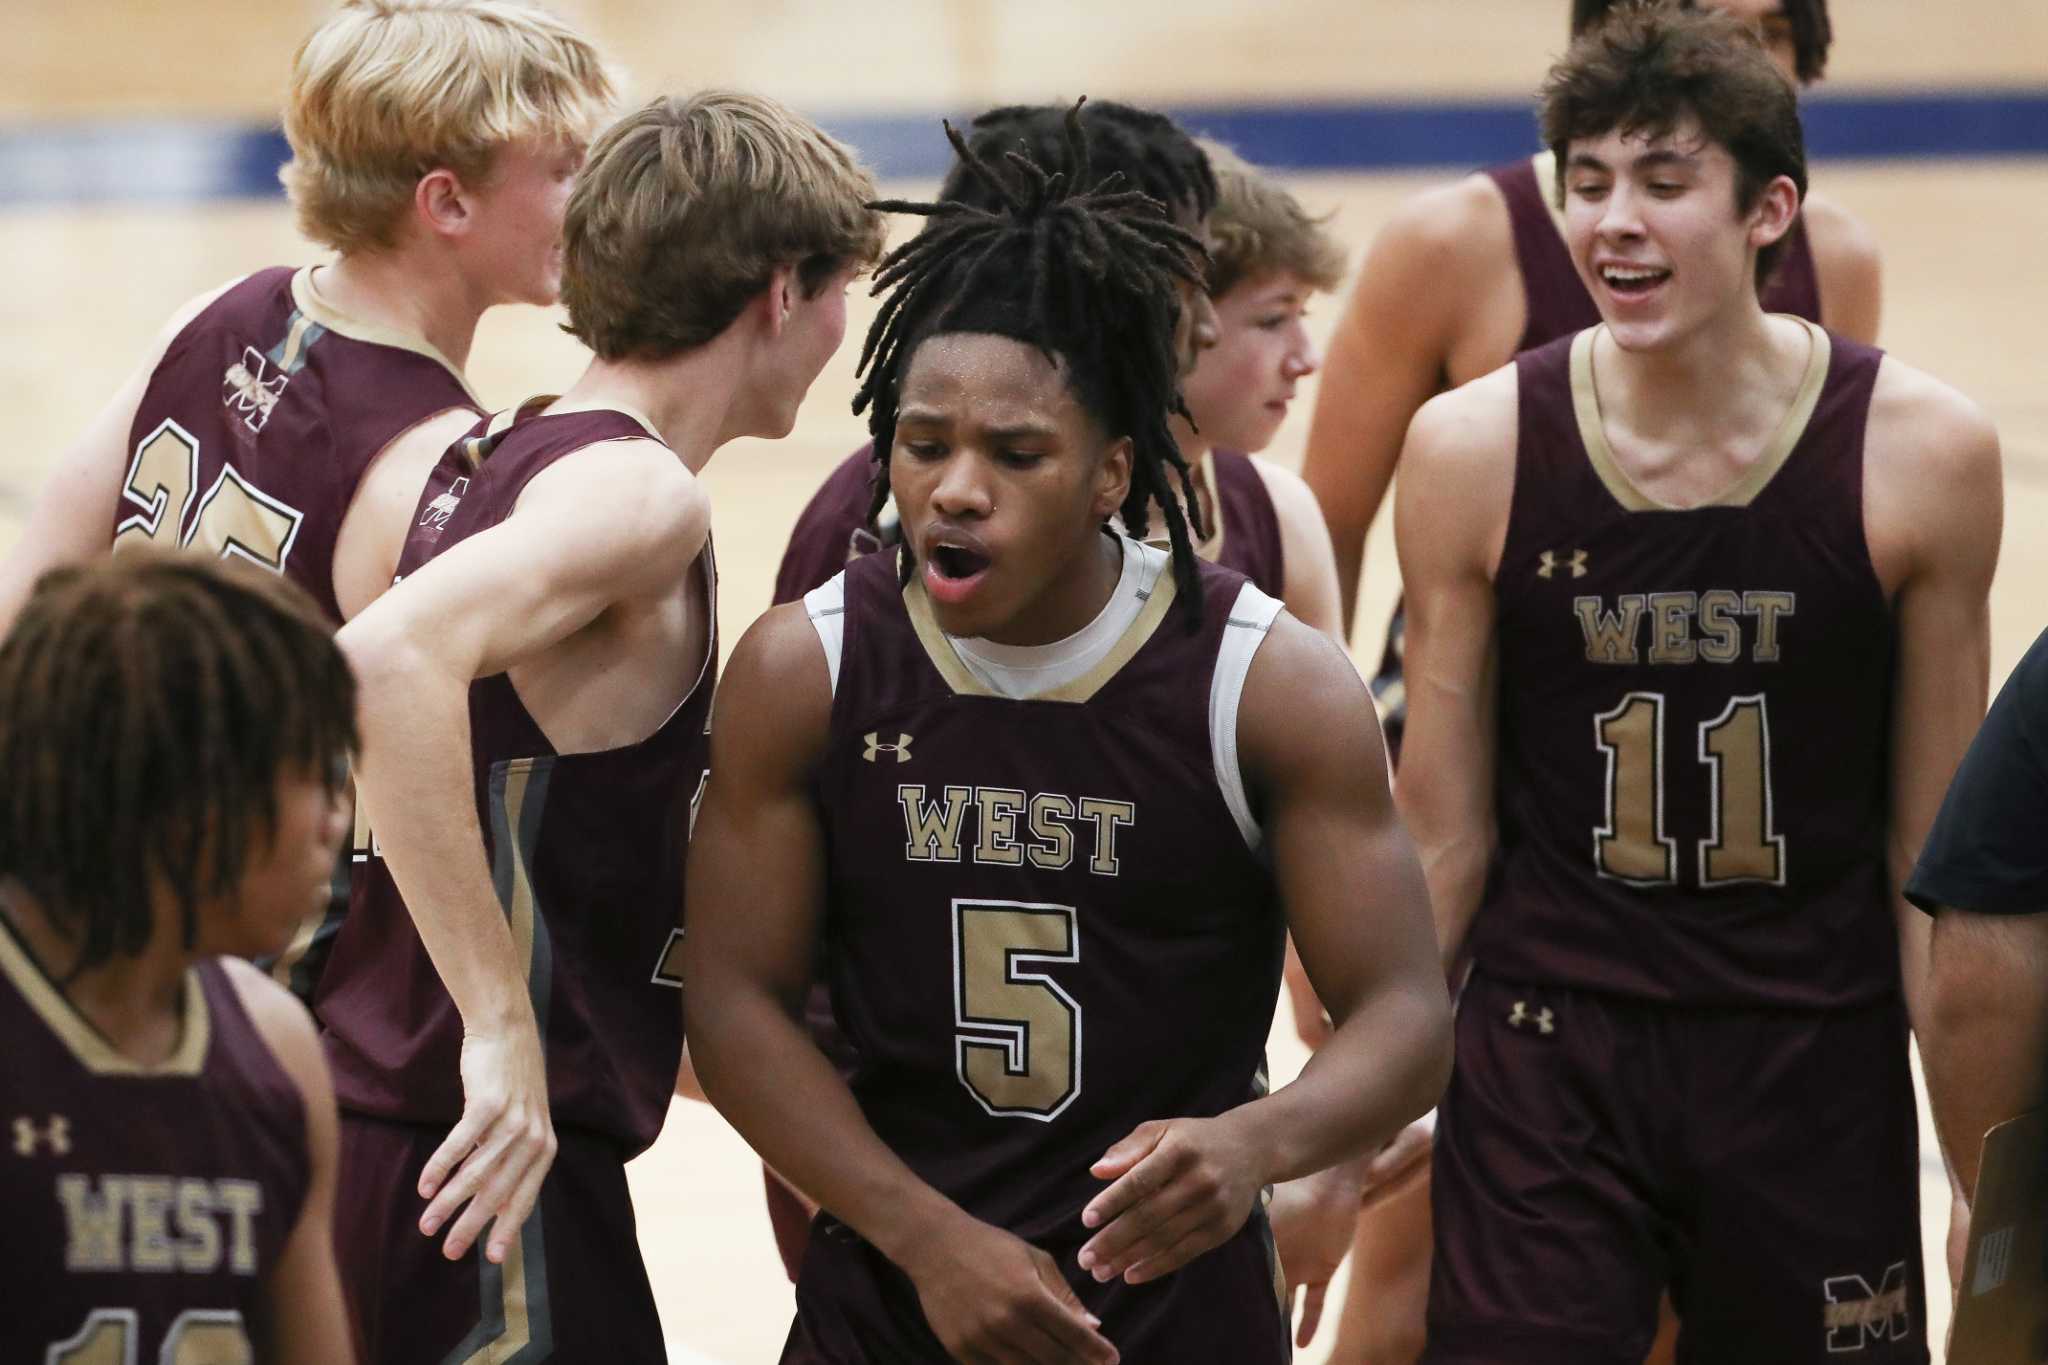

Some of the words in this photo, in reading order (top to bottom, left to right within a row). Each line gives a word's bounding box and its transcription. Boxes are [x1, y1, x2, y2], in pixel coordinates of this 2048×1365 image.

[1573, 589, 1796, 665] WEST
[898, 784, 1135, 876] WEST
[1593, 692, 1786, 887] 11
[951, 898, 1083, 1123] 5
[57, 1173, 264, 1276] WEST
